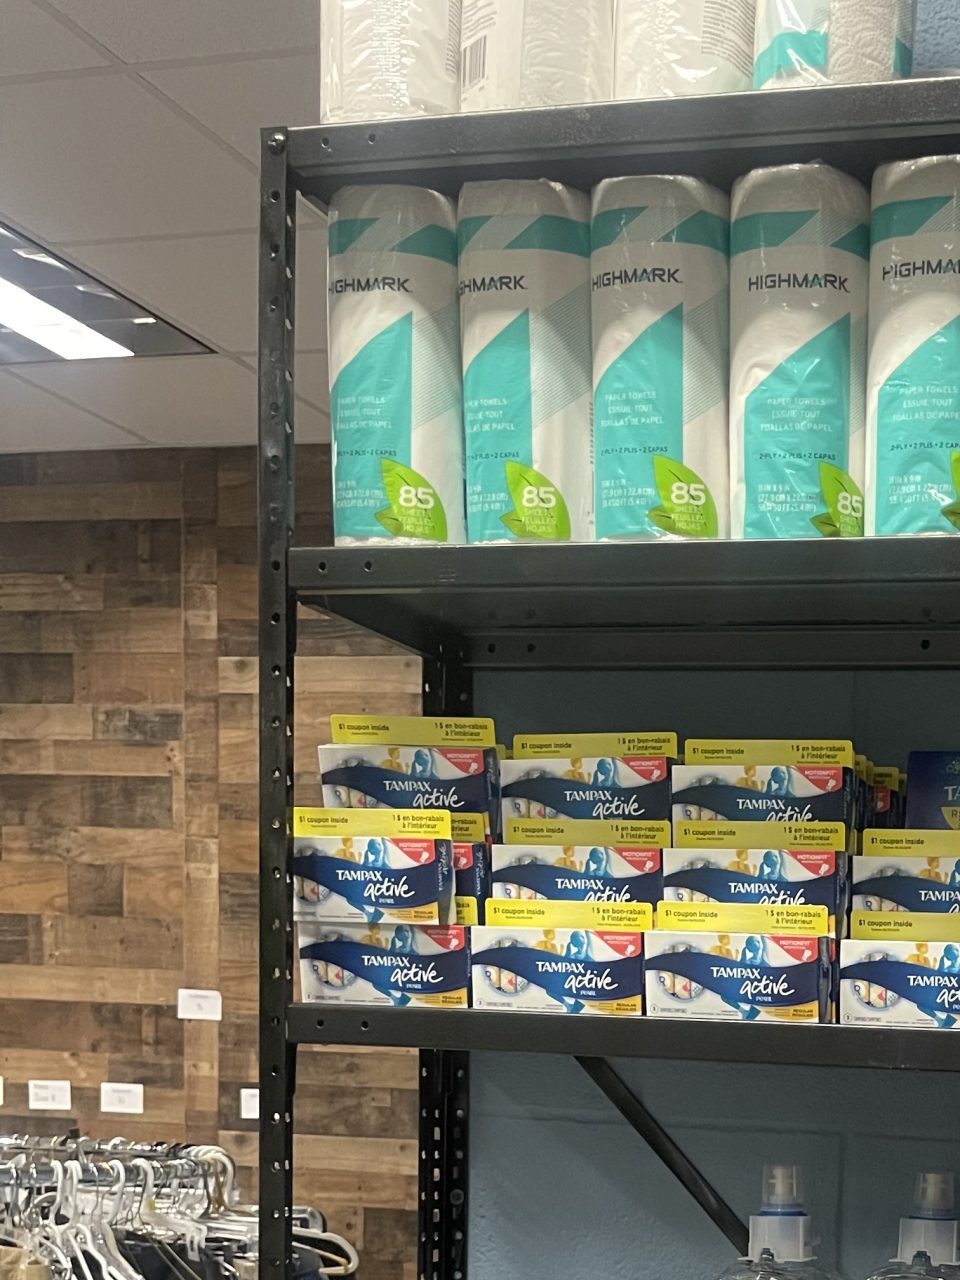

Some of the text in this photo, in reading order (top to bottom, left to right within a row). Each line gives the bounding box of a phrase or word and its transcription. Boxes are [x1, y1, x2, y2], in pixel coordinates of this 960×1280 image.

[592, 268, 682, 292] HIGHMARK
[749, 273, 851, 293] HIGHMARK
[398, 484, 435, 510] 85
[521, 485, 556, 508] 85
[670, 482, 706, 506] 85
[837, 491, 863, 518] 85
[383, 780, 430, 792] TAMPAX
[564, 791, 612, 801] TAMPAX
[412, 786, 465, 809] active
[592, 795, 645, 818] active
[736, 799, 785, 810] TAMPAX
[336, 870, 383, 881] TAMPAX
[555, 878, 604, 890] TAMPAX
[363, 876, 415, 900] active
[728, 883, 778, 894] TAMPAX
[867, 920, 892, 928] coupon
[893, 919, 913, 927] inside
[361, 955, 410, 967] TAMPAX
[536, 961, 585, 973] TAMPAX
[390, 962, 443, 987] active
[564, 968, 619, 994] active
[710, 966, 761, 979] TAMPAX
[907, 975, 959, 987] TAMPAX
[739, 974, 795, 1000] active
